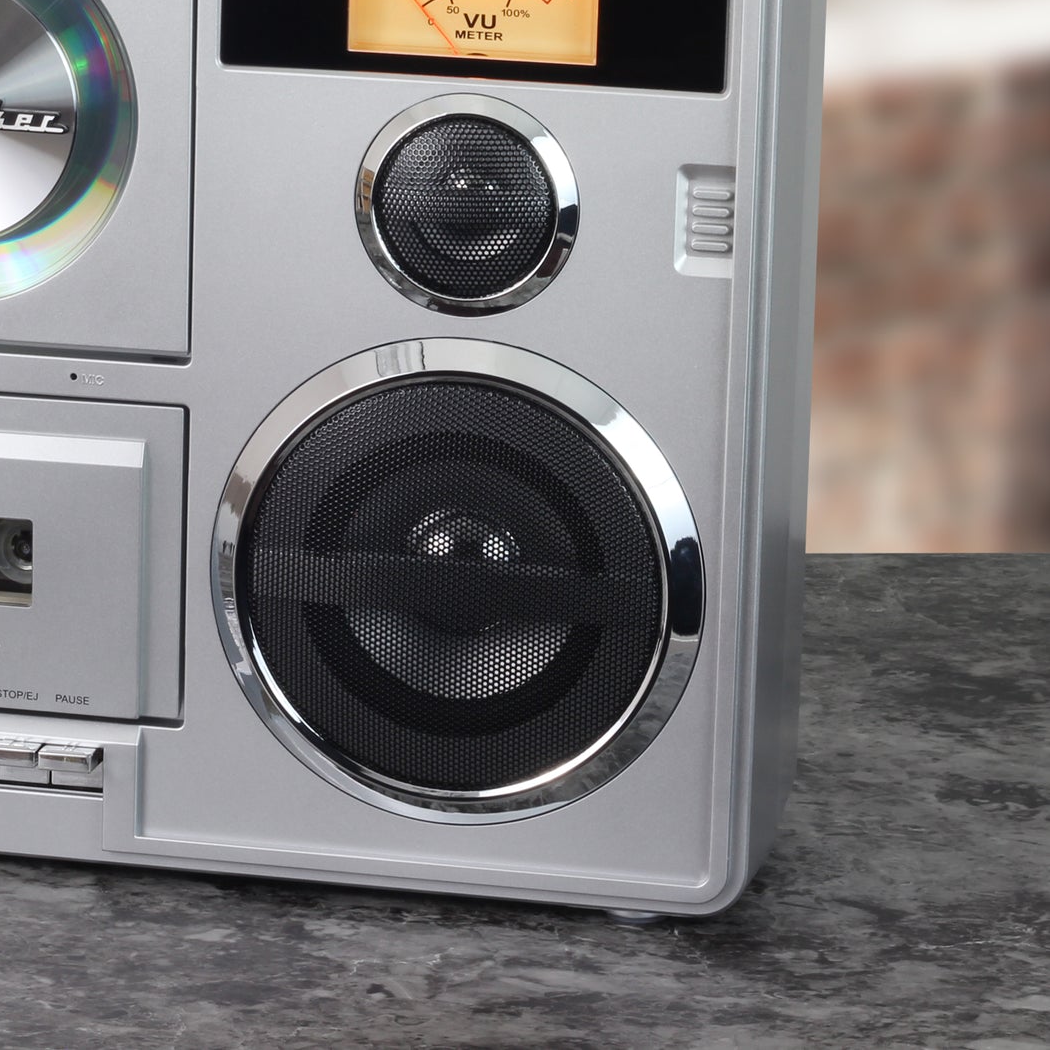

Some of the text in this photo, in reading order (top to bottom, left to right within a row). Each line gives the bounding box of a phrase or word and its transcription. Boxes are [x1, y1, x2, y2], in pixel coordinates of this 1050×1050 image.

[446, 5, 460, 15] 50
[501, 8, 531, 19] 100%
[463, 12, 497, 29] VU
[454, 29, 503, 41] METER
[81, 373, 105, 386] MIC
[55, 693, 90, 706] PAUSE
